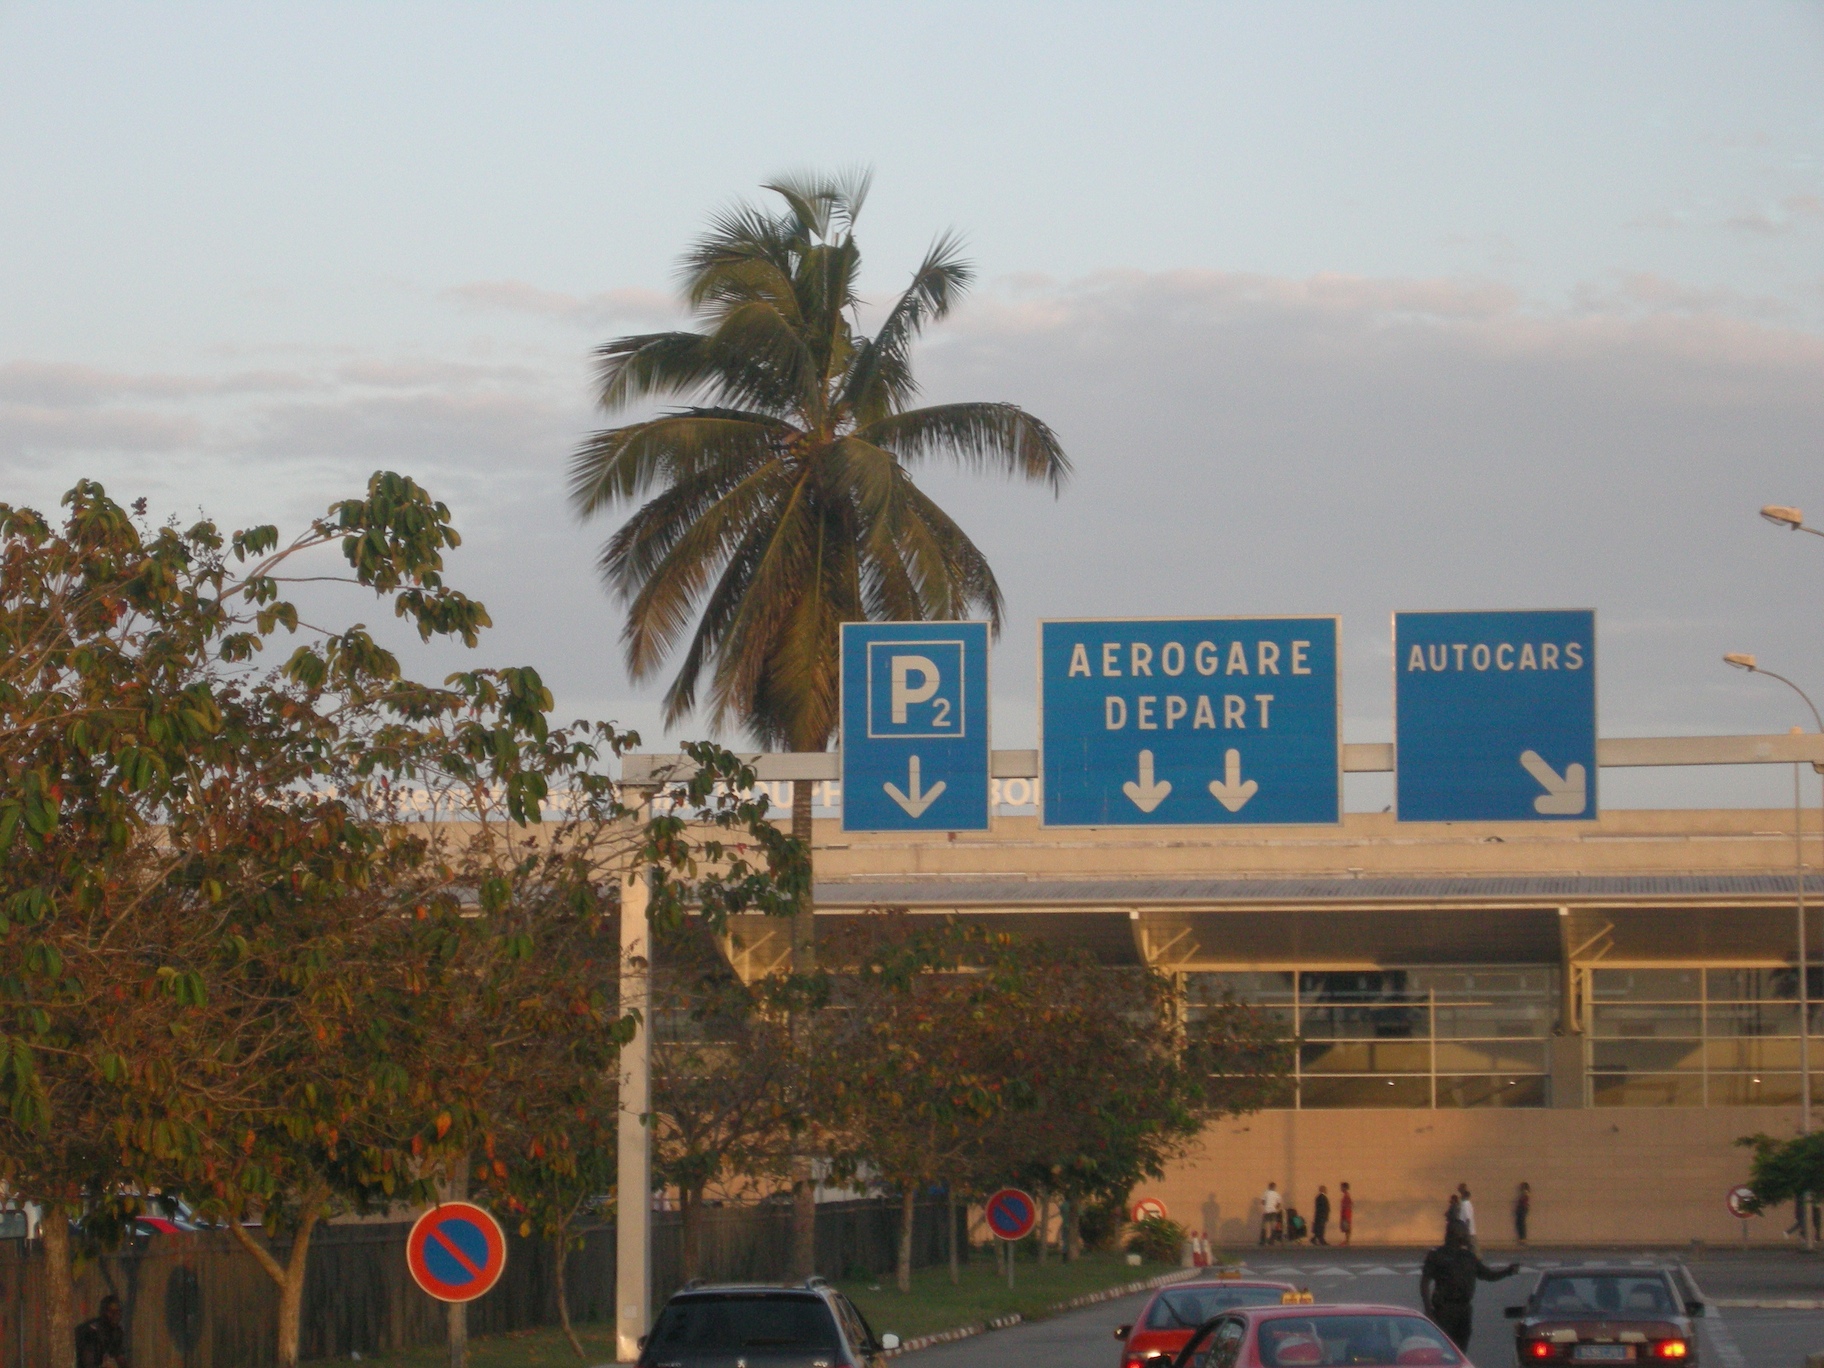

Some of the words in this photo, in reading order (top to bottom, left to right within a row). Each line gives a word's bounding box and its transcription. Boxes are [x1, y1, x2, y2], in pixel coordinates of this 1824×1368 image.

[1068, 640, 1312, 678] AEROGARE
[1408, 642, 1583, 672] AUTOCARS
[1105, 694, 1274, 730] DEPART
